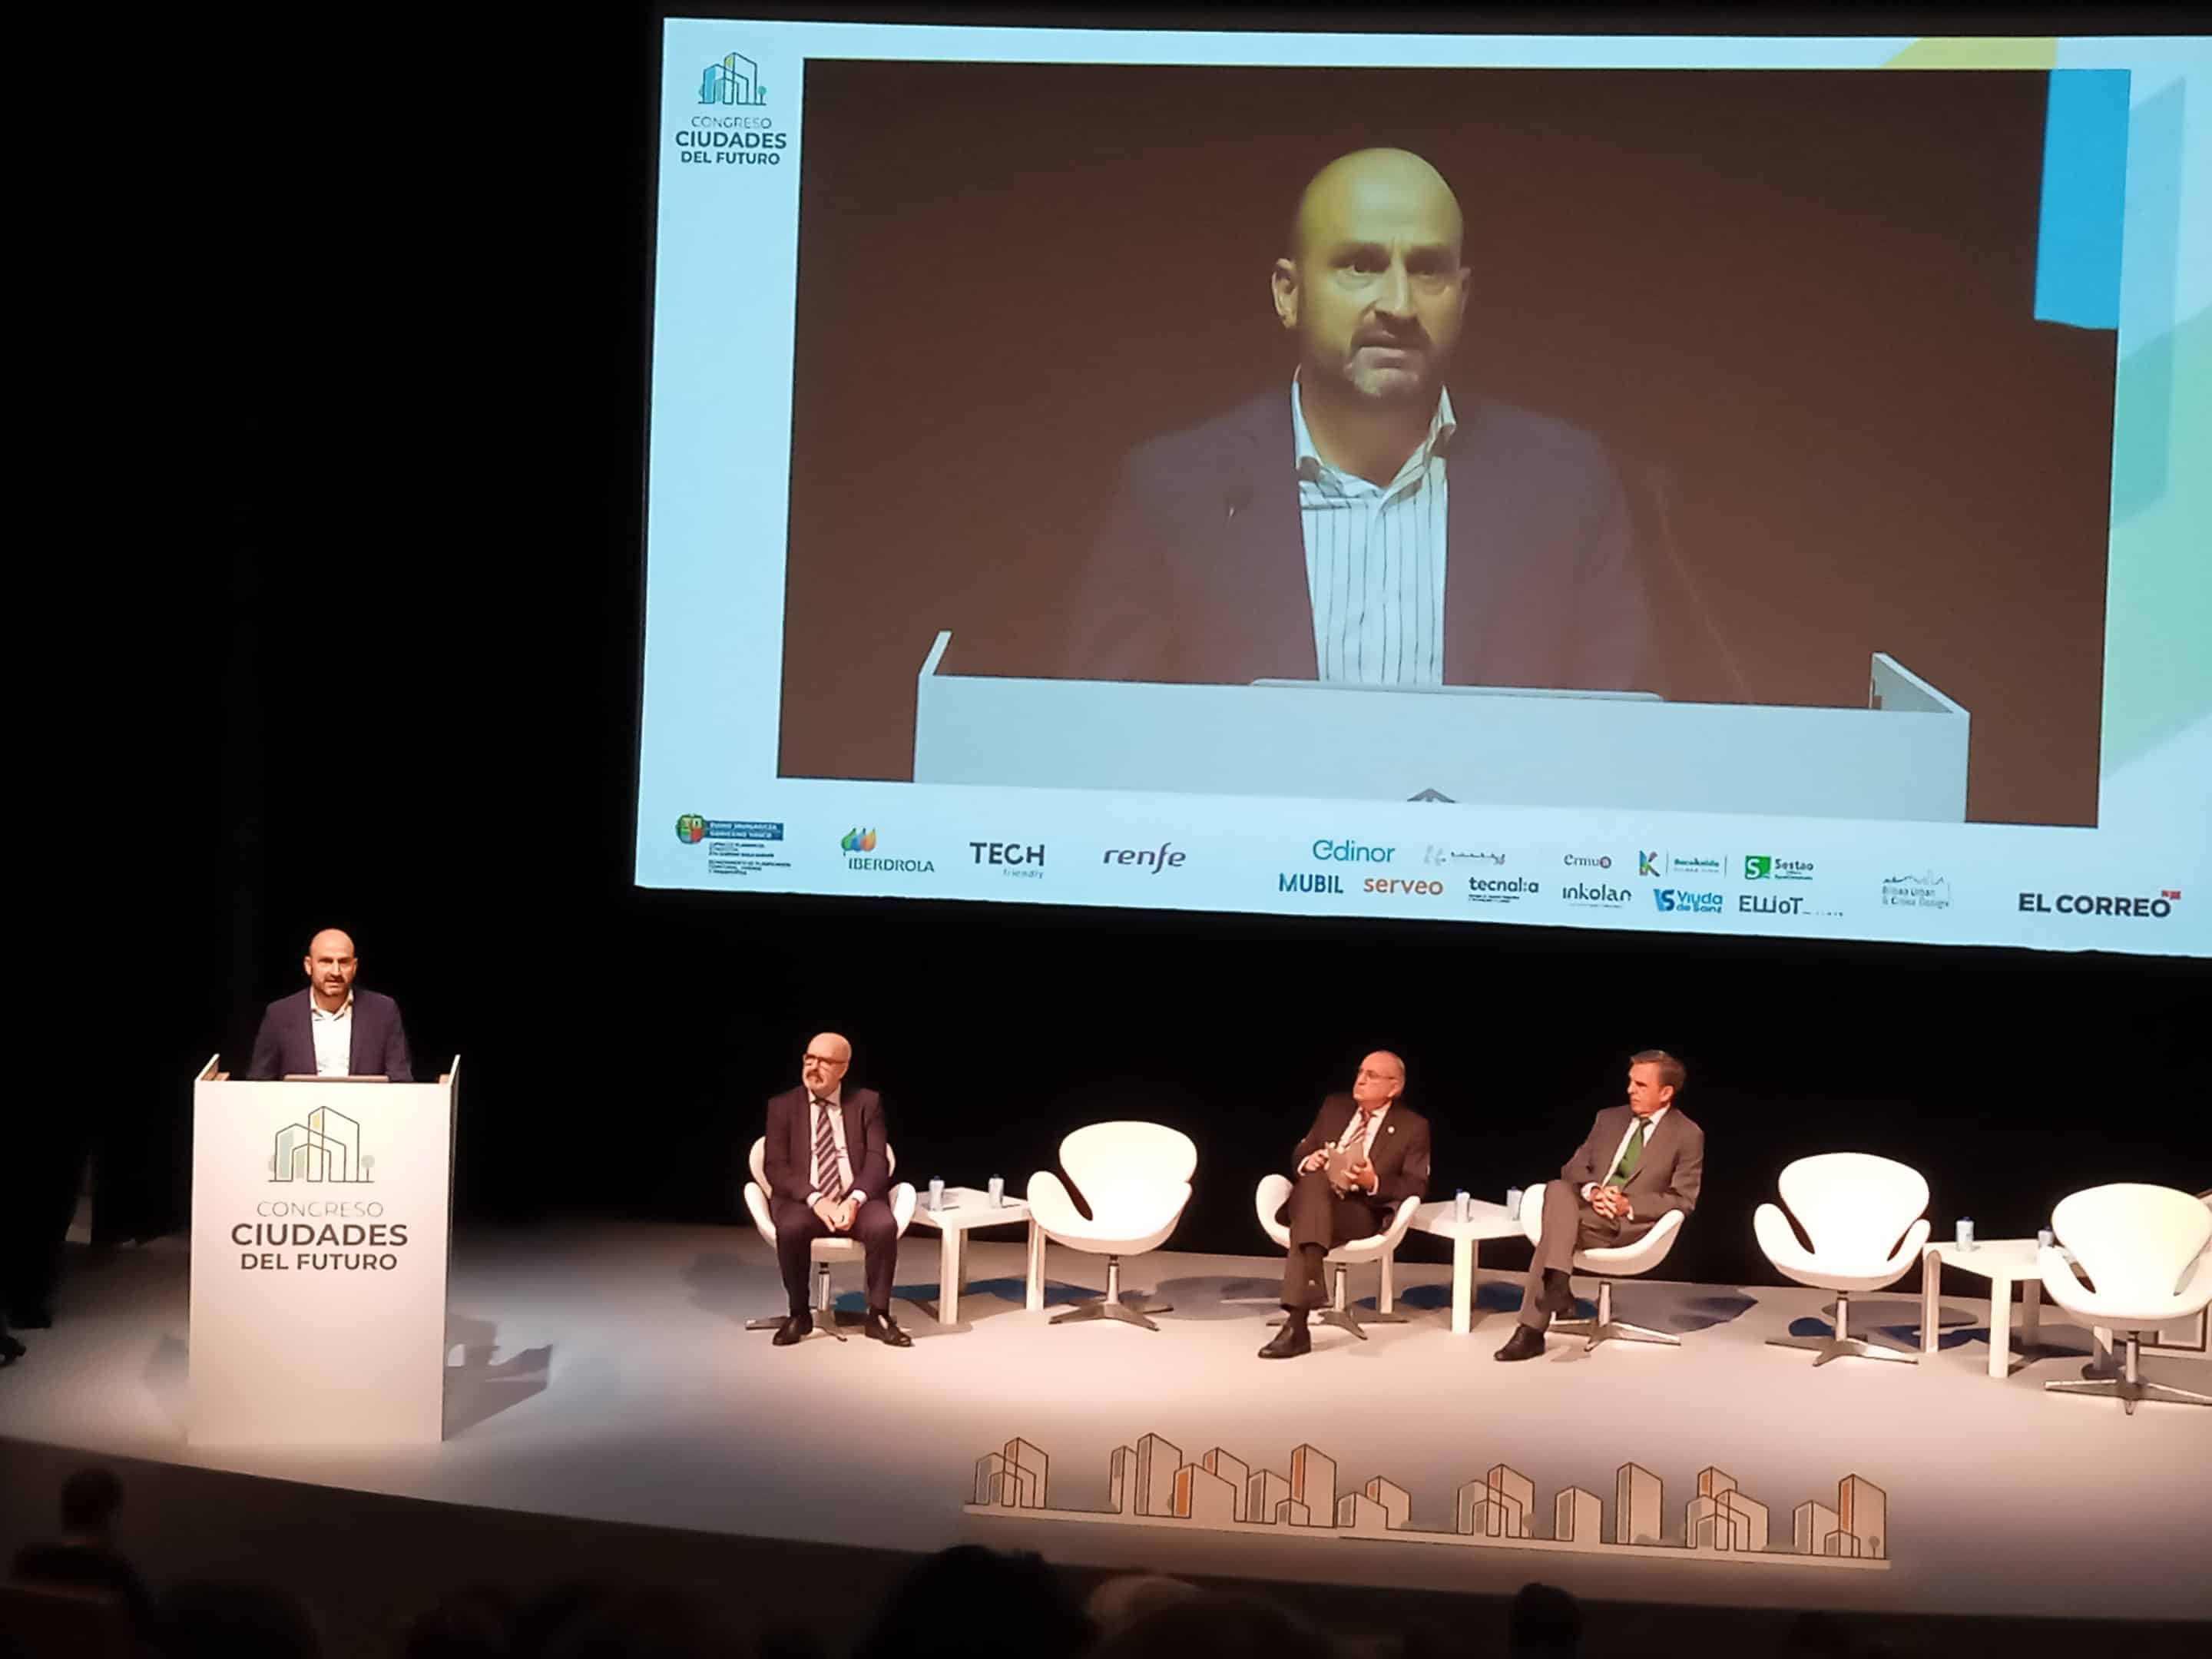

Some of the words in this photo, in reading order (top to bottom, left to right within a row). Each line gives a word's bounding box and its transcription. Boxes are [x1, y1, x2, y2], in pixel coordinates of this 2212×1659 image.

[691, 116, 772, 129] CONGRESO
[675, 131, 787, 149] CIUDADES
[680, 151, 712, 164] DEL
[716, 152, 781, 165] FUTURO
[969, 841, 1045, 866] TECH
[1103, 842, 1187, 875] renfe
[848, 857, 935, 873] IBERDROLA
[1279, 873, 1344, 894] MUBIL
[1363, 878, 1444, 896] serveo
[1562, 882, 1632, 901] inkolan
[1677, 890, 1723, 905] Viuda
[2019, 892, 2051, 912] EL
[2056, 894, 2172, 918] CORREO
[257, 1200, 384, 1218] CONGRESO
[231, 1223, 409, 1247] CIUDADES
[240, 1253, 290, 1270] DEL
[296, 1253, 398, 1270] FUTURO
